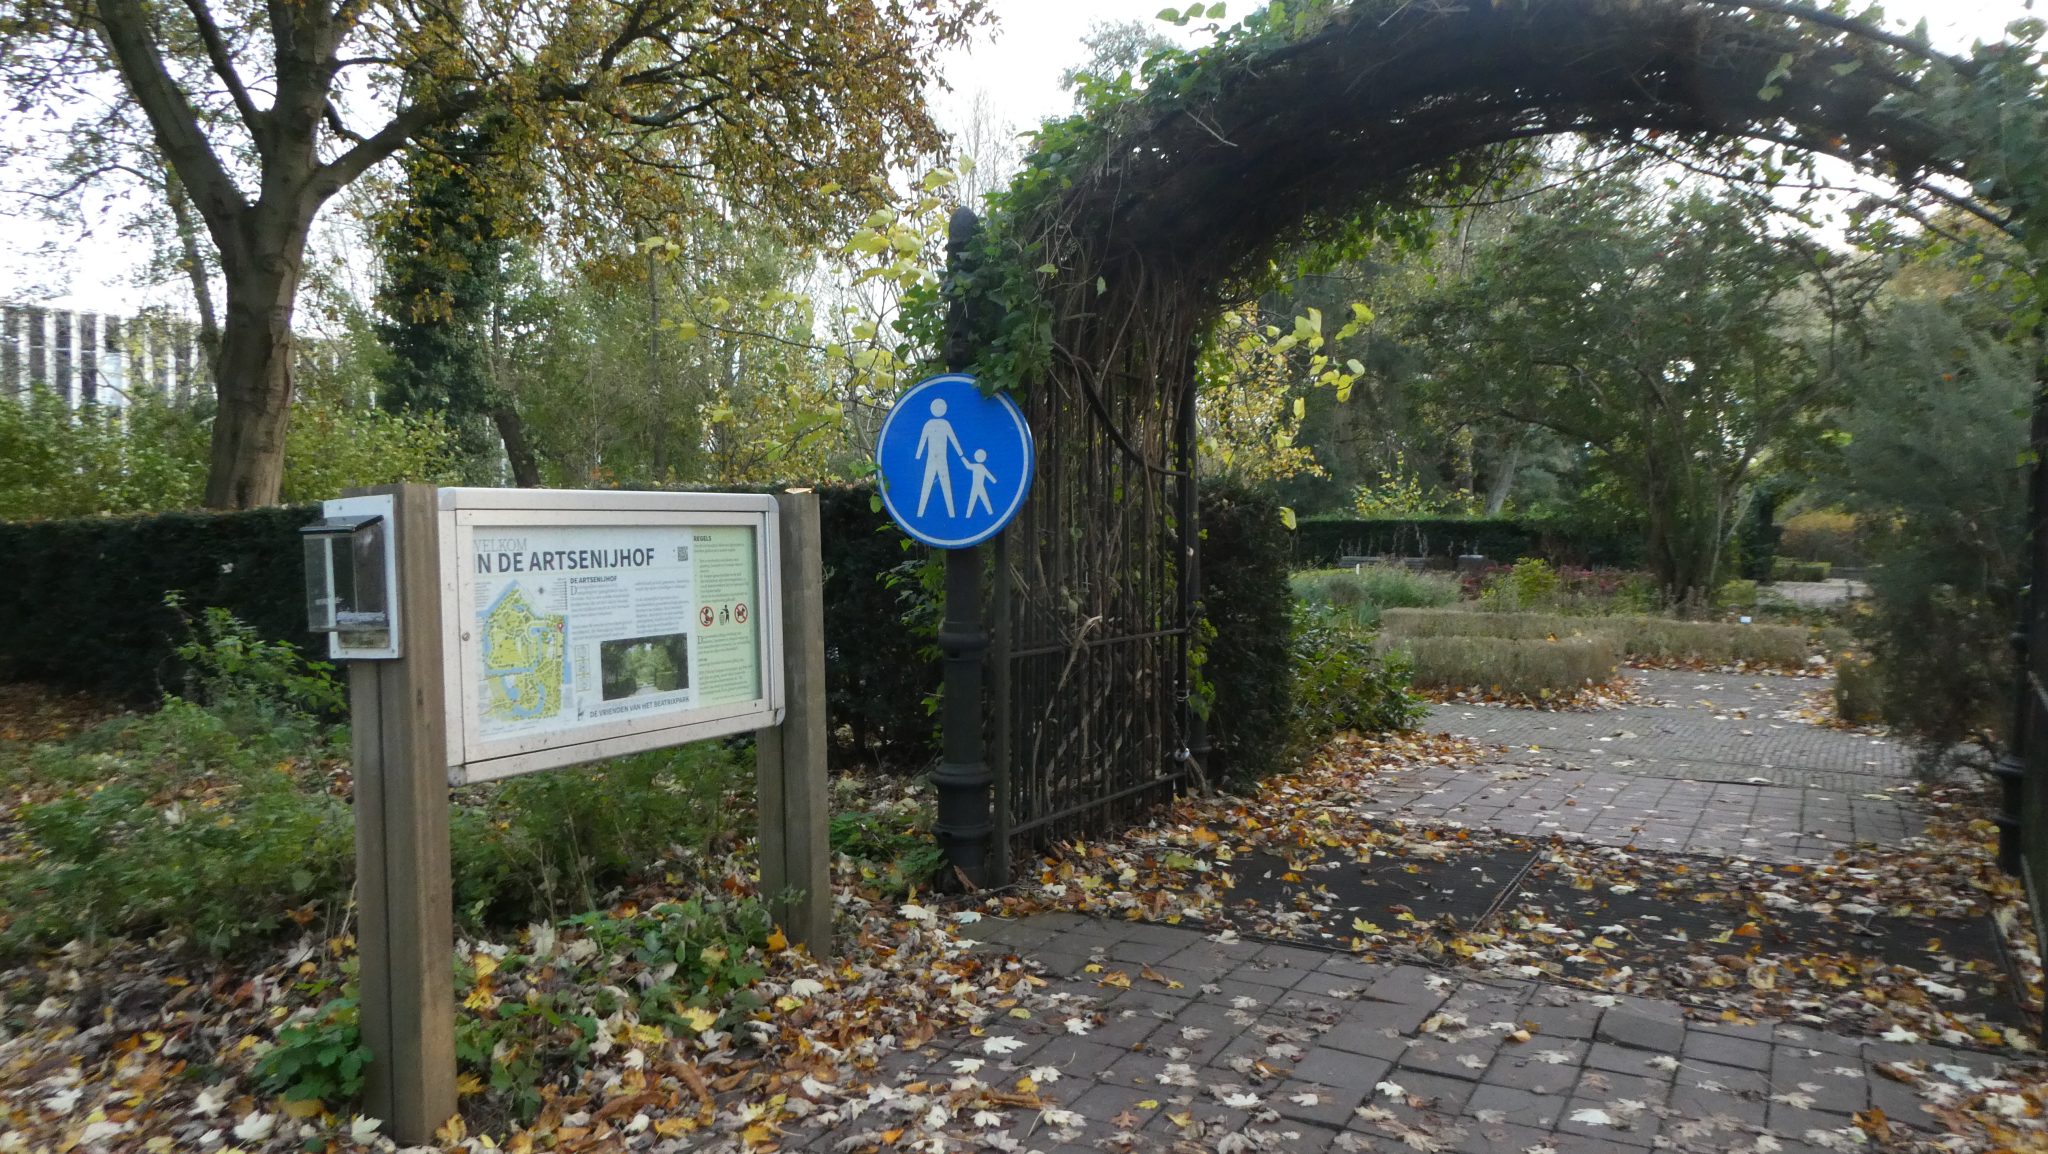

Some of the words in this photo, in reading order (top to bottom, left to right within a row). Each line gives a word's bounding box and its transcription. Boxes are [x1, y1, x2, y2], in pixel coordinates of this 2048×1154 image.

[498, 551, 524, 572] DE
[529, 548, 654, 572] ARTSENIJHOF
[600, 705, 629, 716] VRIENDEN
[630, 703, 640, 712] VAN
[654, 696, 690, 707] BEATRIXPARK
